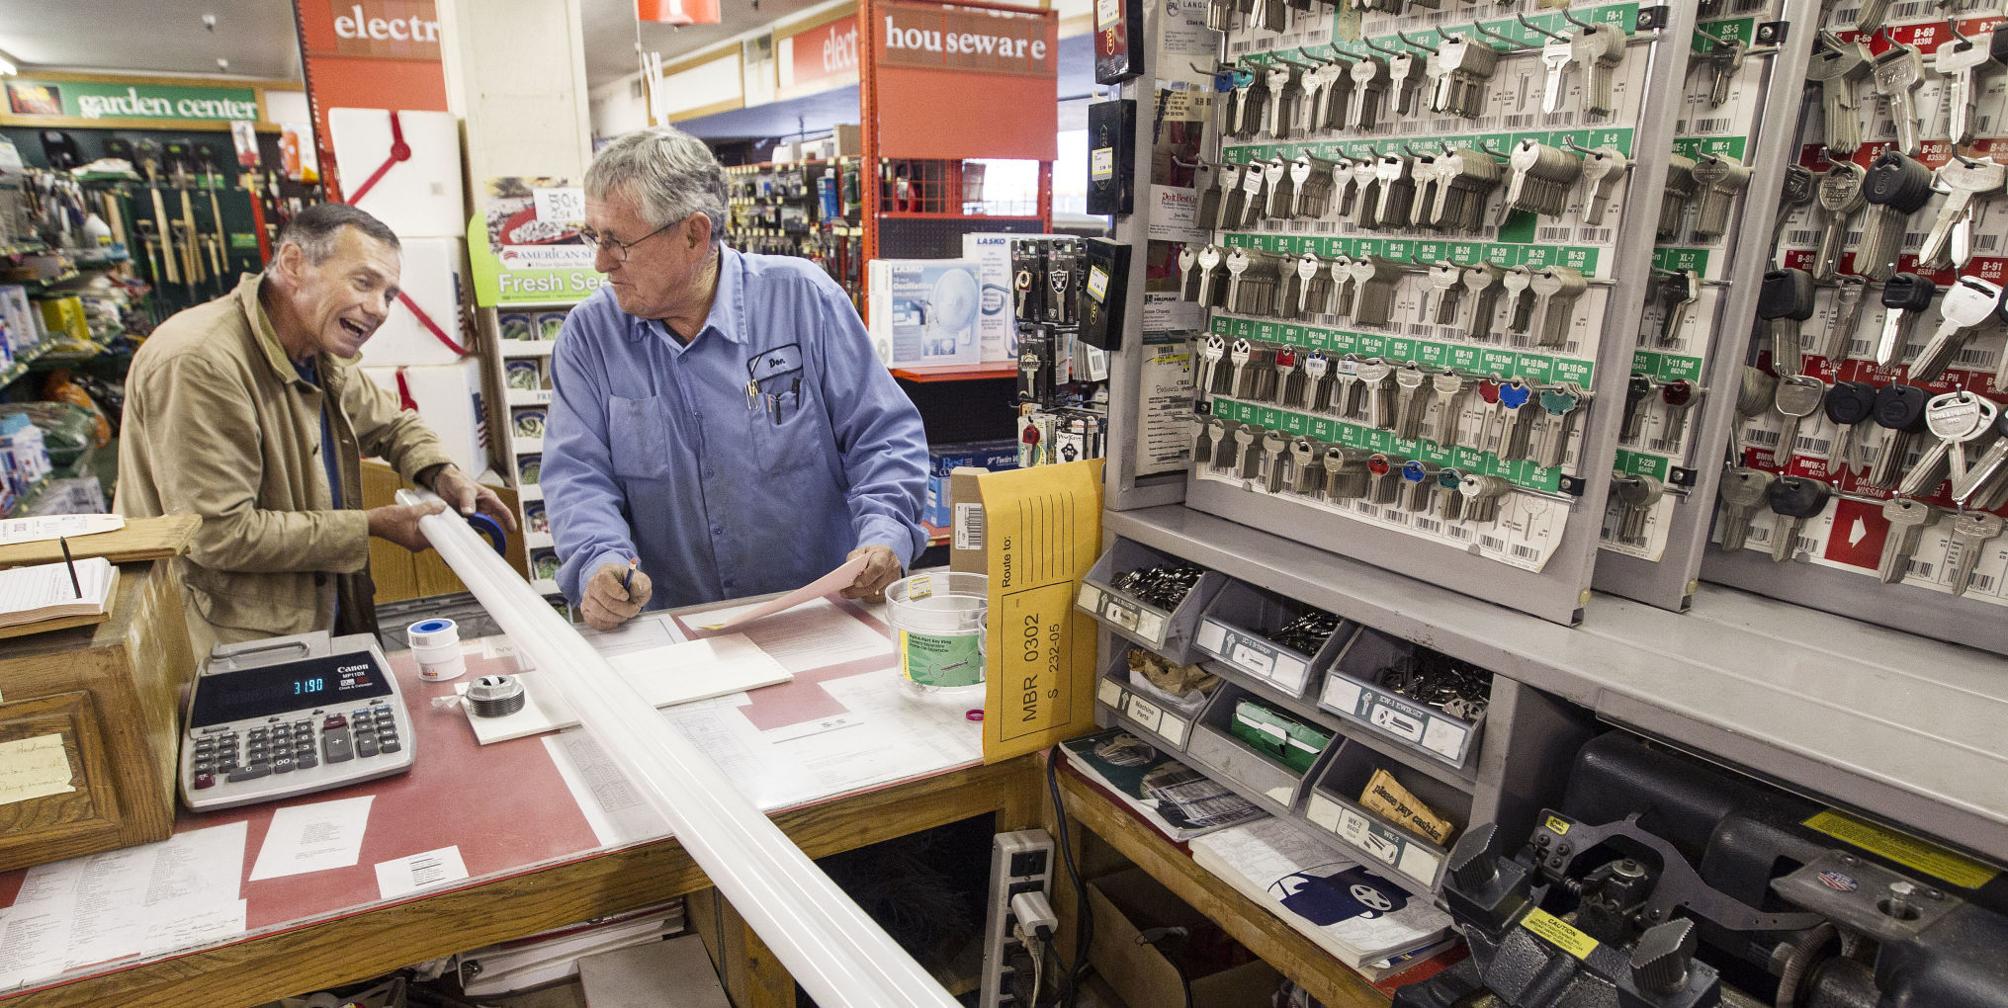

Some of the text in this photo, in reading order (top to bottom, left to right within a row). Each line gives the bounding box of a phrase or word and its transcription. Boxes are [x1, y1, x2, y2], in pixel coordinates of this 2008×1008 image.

[1607, 10, 1622, 20] FA-1
[1722, 24, 1739, 34] SS-5
[1914, 28, 1935, 38] B-69
[885, 16, 1046, 59] houseware
[77, 88, 258, 120] garden center
[1922, 144, 1941, 154] B-80
[976, 238, 1006, 246] LASKO
[1568, 251, 1586, 260] IN-33
[1680, 253, 1696, 262] XL-7
[1982, 262, 2003, 271] B-91
[498, 273, 564, 294] Fresh
[1889, 366, 1902, 376] PH
[1946, 373, 1959, 382] PH
[1800, 460, 1826, 471] BMW-3
[1856, 486, 1886, 499] NISSAN
[1002, 535, 1012, 588] Route to:
[1047, 623, 1061, 700] S 232-05
[337, 663, 369, 674] Canon
[1022, 612, 1040, 723] MBR 0302
[1134, 699, 1155, 716] Machine
[1136, 709, 1150, 721] Parts
[1372, 784, 1442, 841] please pay cashier
[1546, 917, 1577, 938] CAUTION
